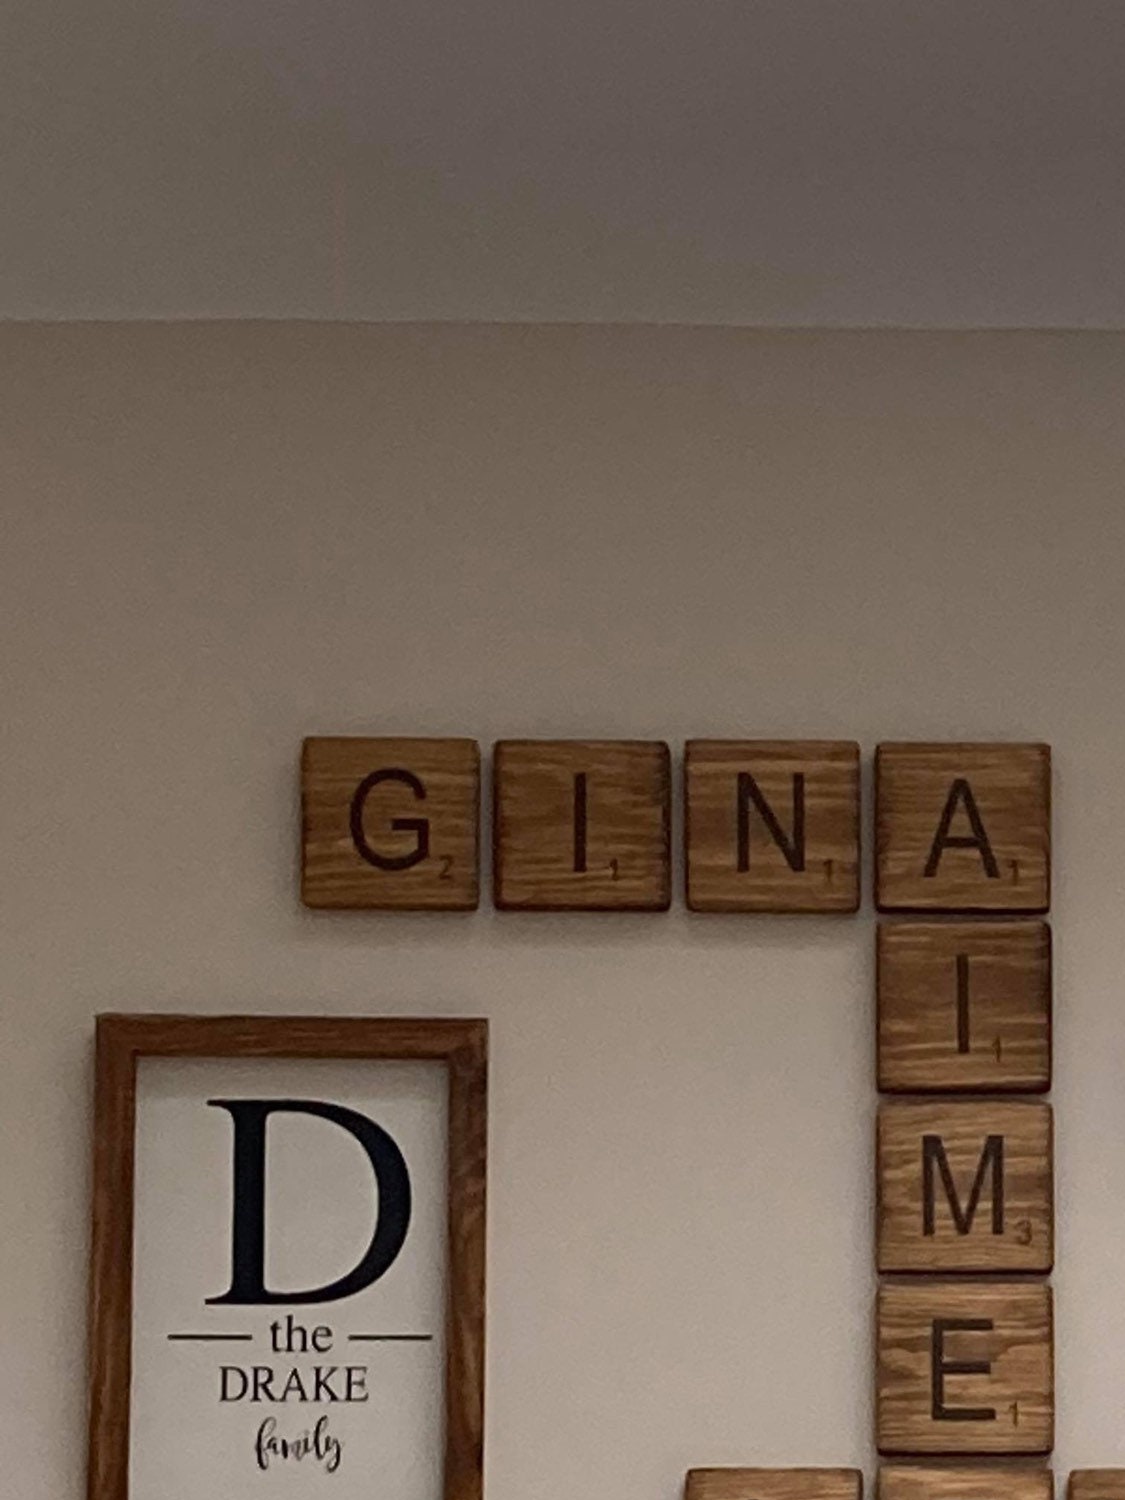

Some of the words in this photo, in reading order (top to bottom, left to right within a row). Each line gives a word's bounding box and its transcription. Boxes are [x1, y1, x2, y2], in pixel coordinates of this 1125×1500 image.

[350, 767, 1000, 877] GINA
[204, 1099, 412, 1305] D
[269, 1315, 334, 1353] the
[219, 1366, 369, 1402] DRAKE
[254, 1414, 342, 1472] family
